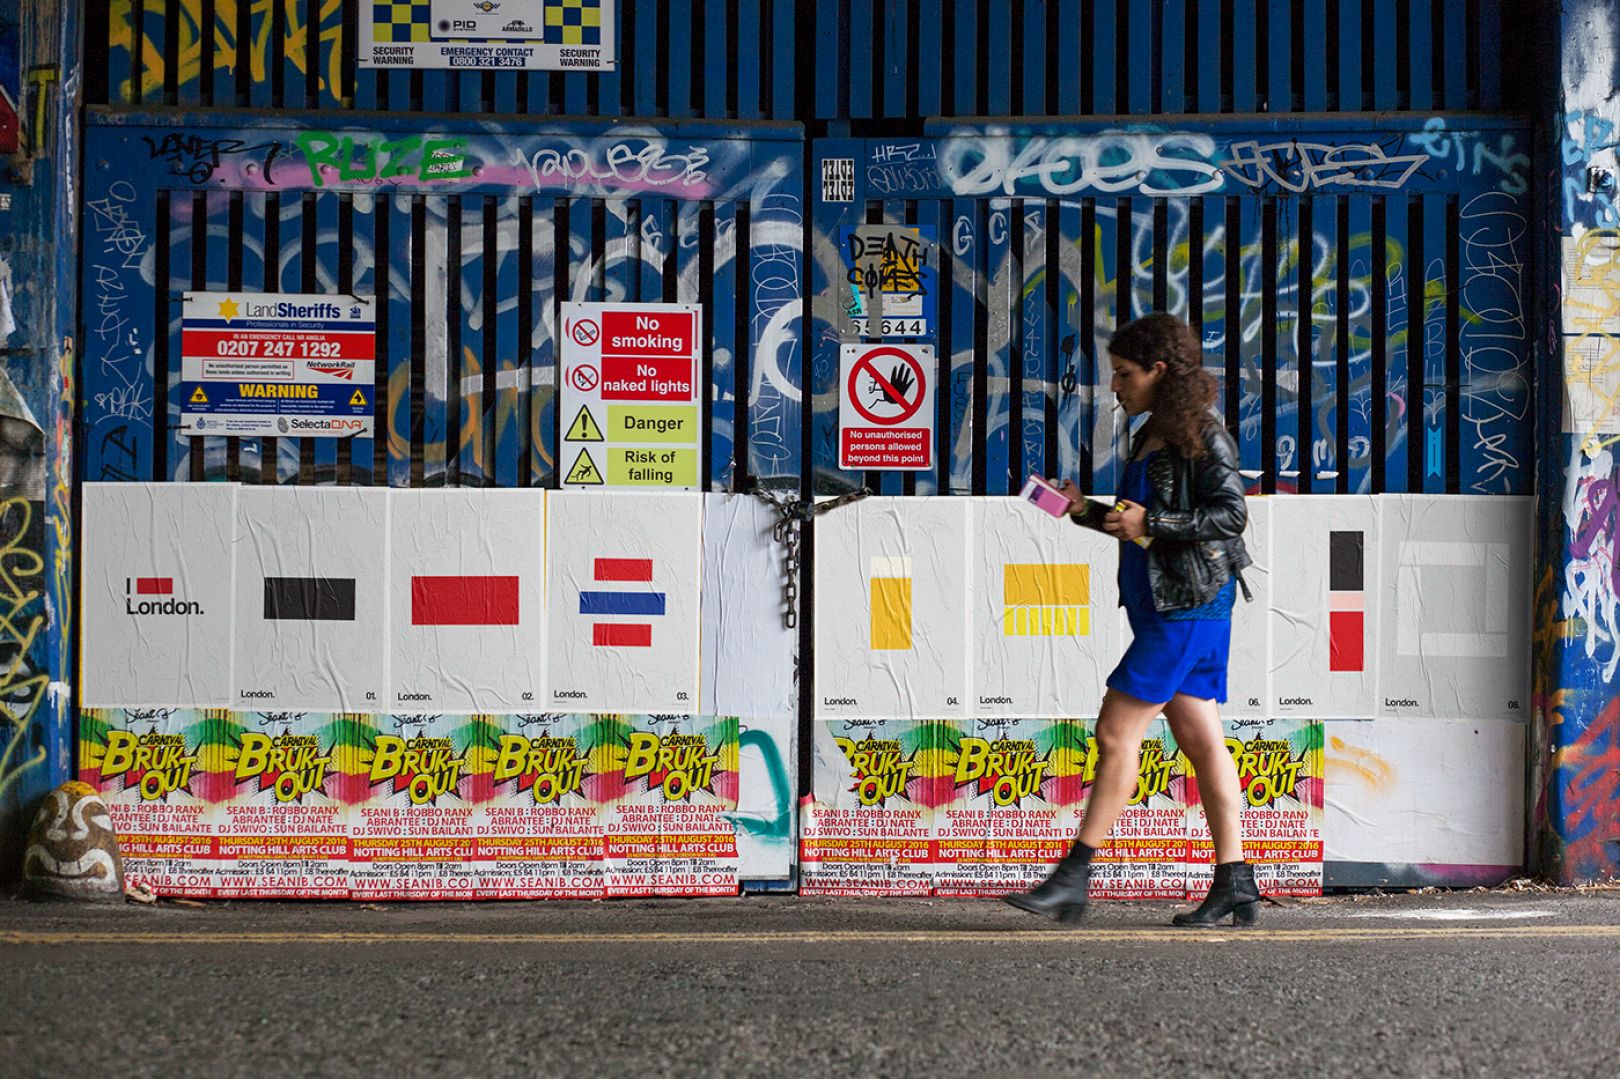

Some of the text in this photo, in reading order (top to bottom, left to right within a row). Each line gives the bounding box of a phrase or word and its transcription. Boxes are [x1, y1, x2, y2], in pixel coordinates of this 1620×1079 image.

[453, 21, 476, 29] PID
[373, 47, 414, 56] SECURITY
[441, 48, 534, 57] EMERGENCY CONTACT
[560, 49, 600, 58] SECURITY
[373, 56, 414, 65] WARNING
[453, 57, 522, 66] 0800 321 3476
[560, 58, 600, 67] WARNING
[246, 302, 340, 319] LandSheriffs
[636, 317, 659, 330] No
[612, 335, 682, 351] smoking
[217, 341, 340, 357] 0207 247 1292
[637, 364, 656, 376] No
[239, 384, 318, 399] WARNING
[604, 379, 690, 394] naked lights
[624, 416, 683, 433] Danger
[850, 430, 922, 440] No unauthorised
[850, 442, 922, 453] persons allowed
[625, 451, 676, 463] Risk of
[848, 454, 924, 464] beyond this point
[628, 468, 672, 483] falling
[126, 577, 130, 594] I
[126, 598, 204, 615] London.
[241, 690, 274, 698] London.
[366, 692, 376, 700] 01.
[398, 693, 432, 701] London.
[522, 692, 534, 700] 02.
[554, 690, 588, 699] London.
[676, 692, 689, 700] 03.
[824, 697, 858, 706] London.
[947, 697, 959, 706] 04.
[980, 696, 1013, 704] London.
[1248, 698, 1260, 707] 06.
[1385, 698, 1419, 707] London.
[1508, 701, 1520, 709] 08.
[139, 735, 184, 746] CARNIVAL
[272, 736, 317, 747] CARNIVAL
[406, 738, 451, 750] CARNIVAL
[530, 736, 576, 749] CARNIVAL
[660, 735, 705, 747] CARNIVAL
[856, 739, 900, 752] CARNIVAL
[990, 739, 1034, 752] CARNIVAL
[1245, 739, 1289, 752] CARNIVAL
[100, 730, 184, 777] BRUK
[235, 733, 318, 778] BRUK
[370, 735, 452, 781] BRUK
[494, 733, 575, 780] BRUK
[624, 733, 705, 777] BRUK
[955, 738, 1034, 782] BRUK
[140, 757, 197, 800] OUT
[275, 758, 331, 802] OUT
[409, 760, 464, 805] OUT
[533, 759, 587, 804] OUT
[663, 756, 718, 801] OUT
[859, 762, 913, 806] OUT
[993, 761, 1048, 807] OUT
[1247, 762, 1303, 807] OUT
[227, 806, 256, 815] SEANI
[273, 806, 308, 815] ROBBO
[311, 806, 339, 815] RANX
[232, 816, 286, 824] ABRANTEE
[293, 816, 305, 824] DJ
[552, 817, 562, 826] DJ
[219, 825, 347, 834] DJ SWIVO SUN BAILANTE
[219, 846, 346, 854] NOTTING HILL ARTS CLUB
[804, 848, 928, 857] NOTTING HILL ARTS CLUB
[649, 859, 670, 867] Open
[671, 859, 689, 867] 8pm
[220, 877, 347, 887] WWW.SEANIB.COM
[479, 877, 604, 887] WWW.SEANIB.COM
[610, 874, 735, 885] WWW.SEANIB.COM
[806, 879, 929, 888] WWW.SEANIB.COM
